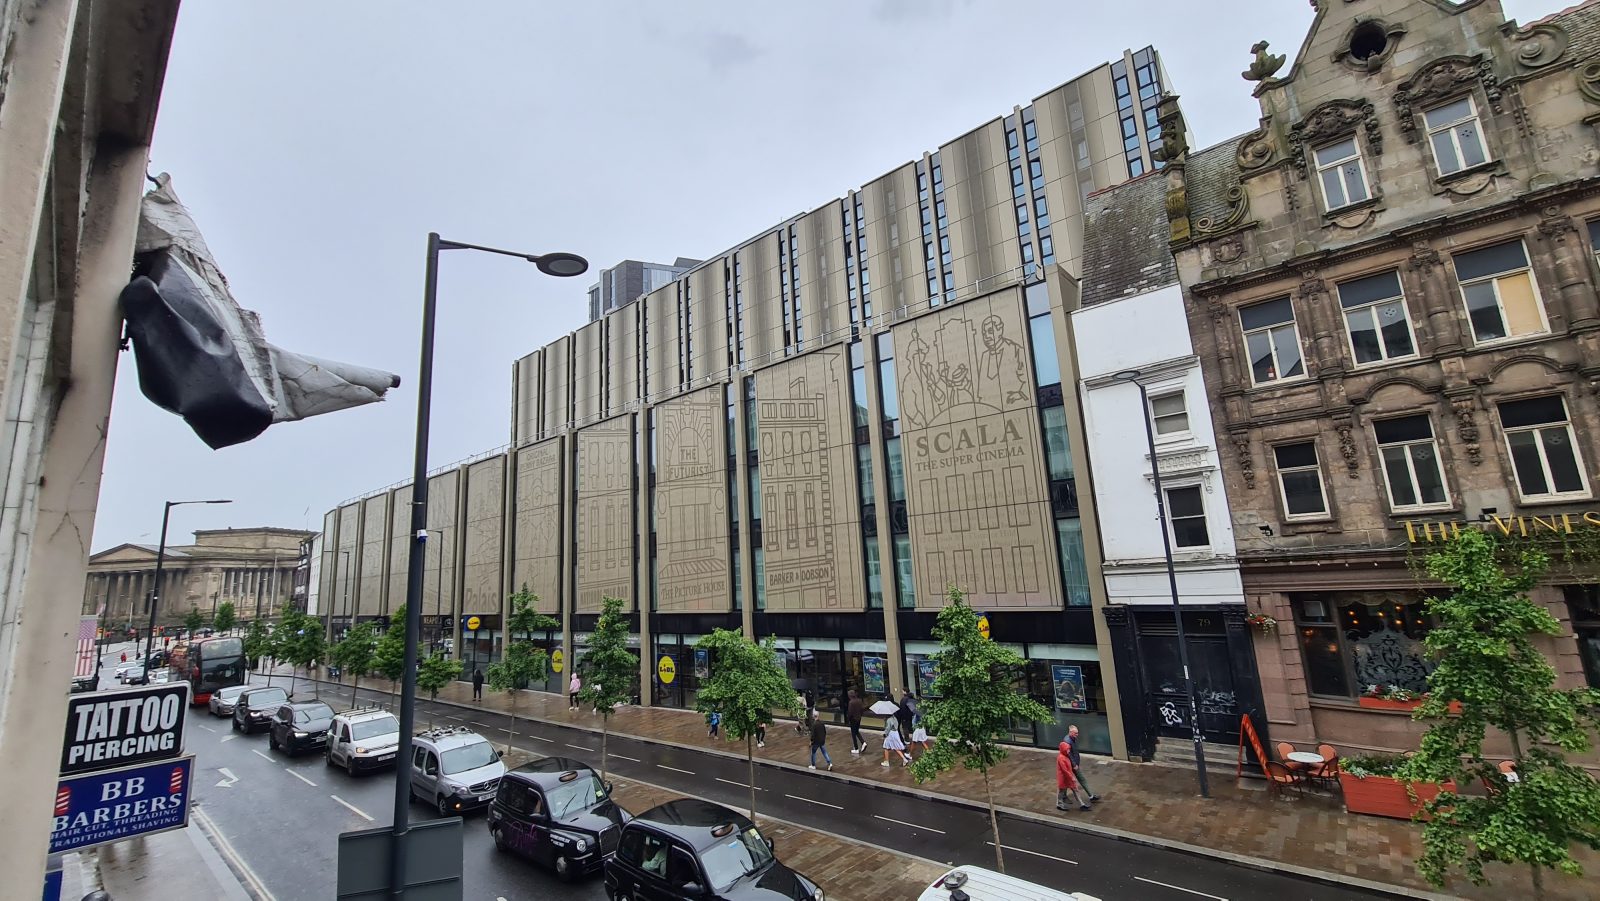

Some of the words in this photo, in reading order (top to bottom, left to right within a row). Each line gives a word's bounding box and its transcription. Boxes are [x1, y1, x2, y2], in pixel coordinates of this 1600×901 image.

[916, 418, 1023, 457] SCALA
[680, 448, 697, 461] THE
[915, 461, 938, 472] THE
[940, 454, 974, 469] SUPER
[976, 445, 1026, 462] CINEMA
[669, 465, 709, 479] FUTURIST
[661, 587, 673, 600] THE
[674, 583, 702, 598] PICTURE
[703, 580, 725, 593] HOUSE
[769, 571, 794, 586] BARKER
[801, 567, 829, 582] DOBSON
[1196, 618, 1211, 627] 79
[75, 693, 180, 742] TATTOO
[68, 732, 175, 765] PIERCING
[100, 777, 145, 802] BB
[50, 828, 81, 839] HAIR
[114, 809, 178, 826] THREADING
[52, 793, 183, 833] BARBERS
[49, 826, 129, 848] RADITIONAL
[132, 816, 179, 830] SHAVING
